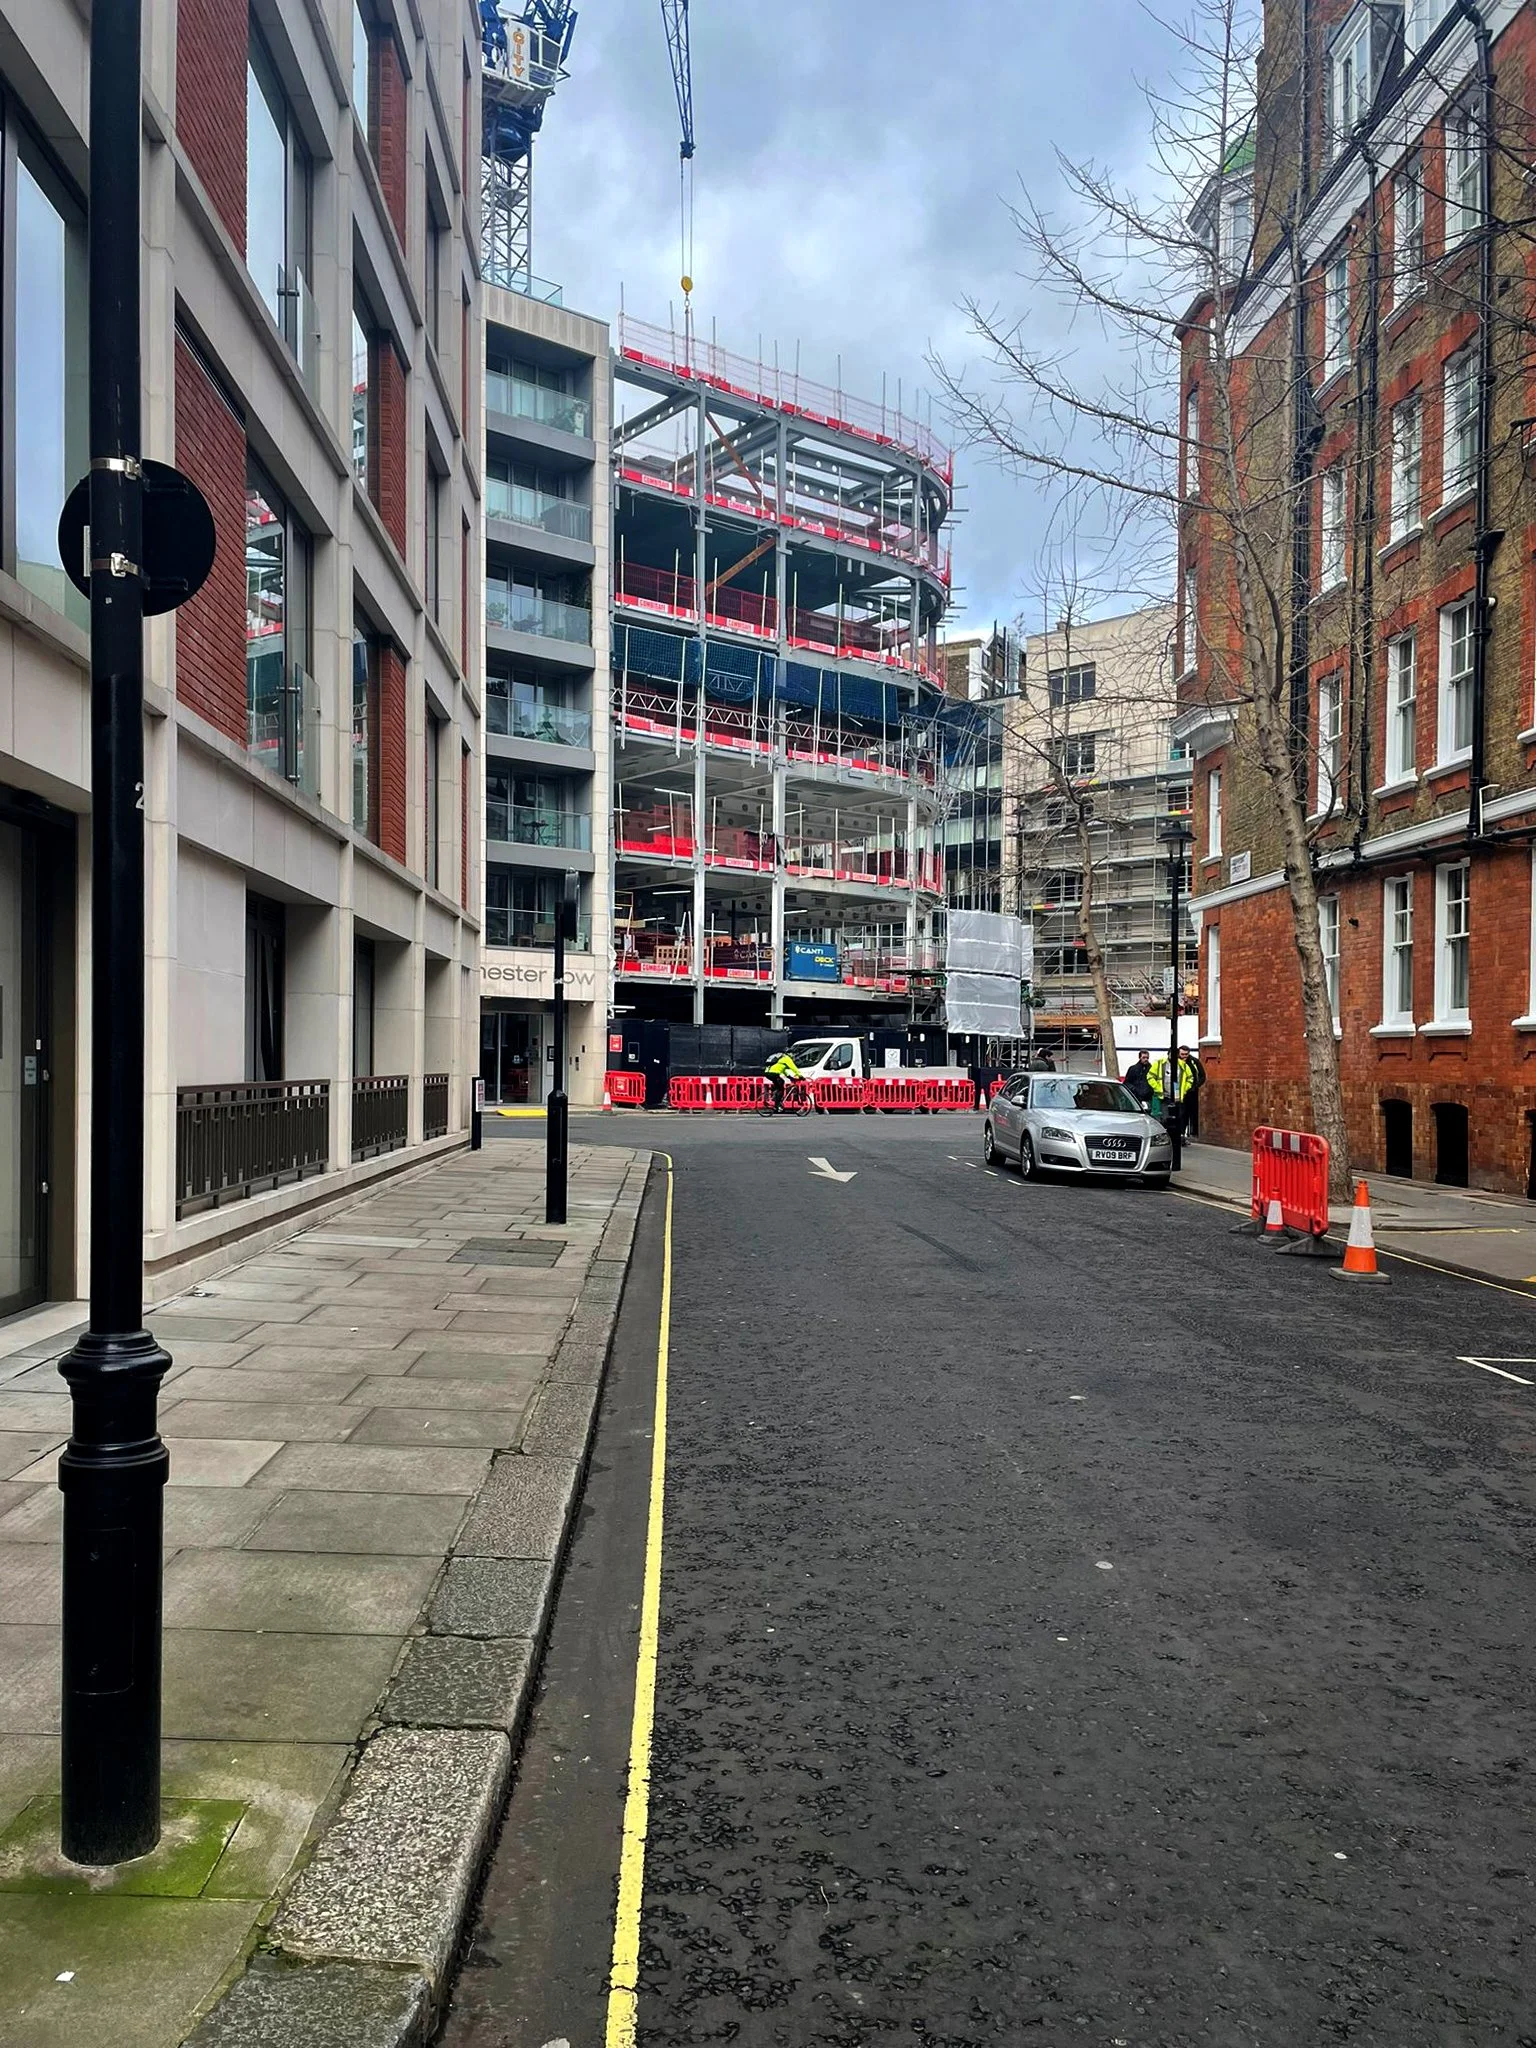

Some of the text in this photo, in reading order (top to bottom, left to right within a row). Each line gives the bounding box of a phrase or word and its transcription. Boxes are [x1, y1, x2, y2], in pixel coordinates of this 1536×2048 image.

[800, 947, 824, 955] CANTI
[563, 971, 595, 985] ow
[1095, 1150, 1133, 1160] RV09 BRF
